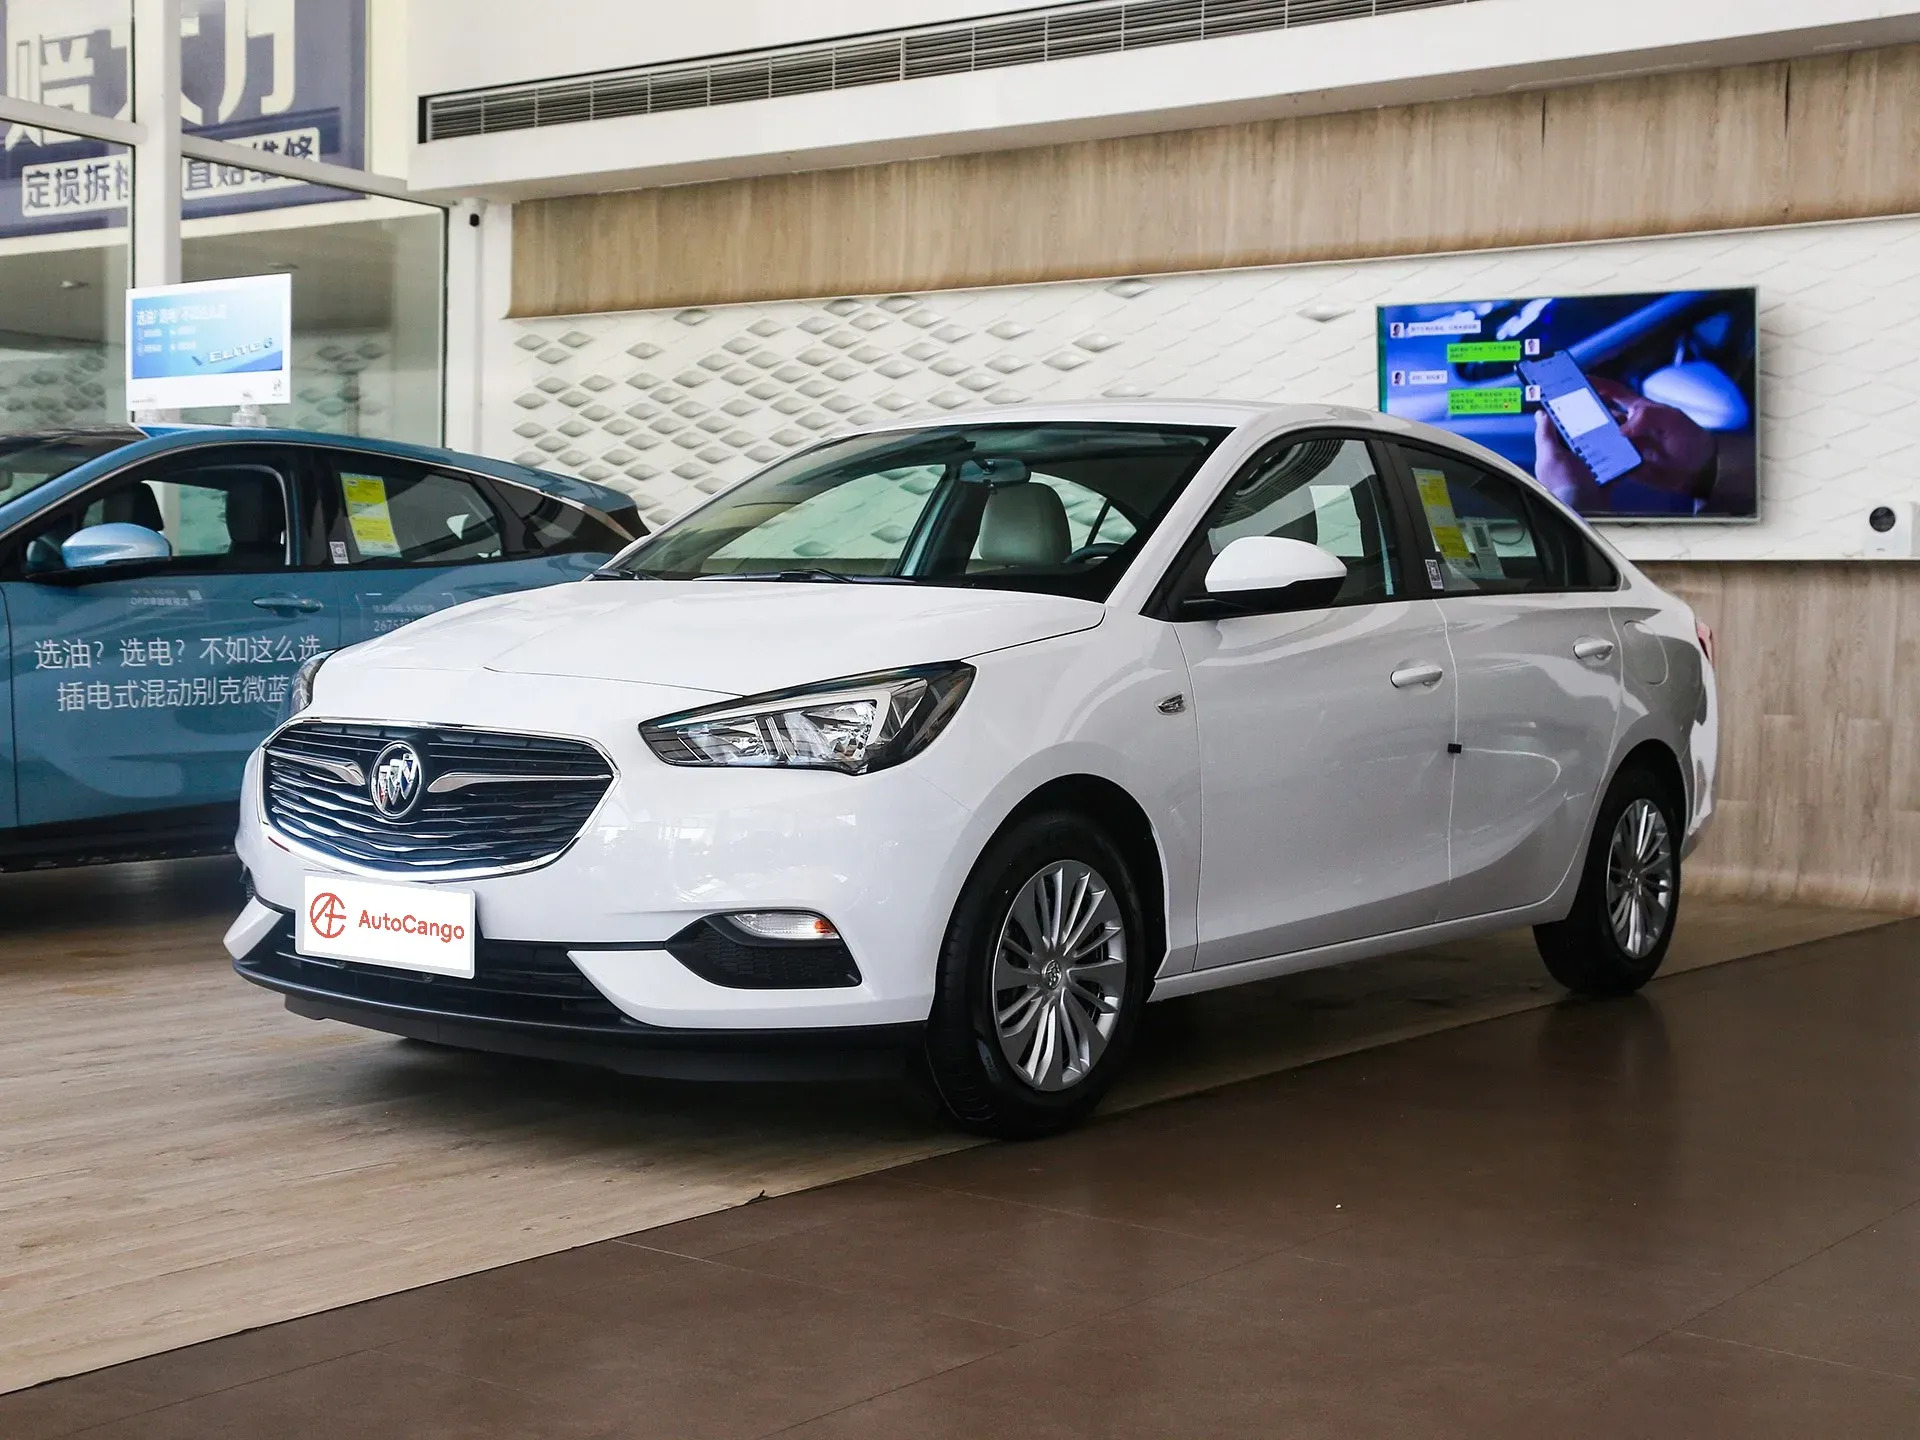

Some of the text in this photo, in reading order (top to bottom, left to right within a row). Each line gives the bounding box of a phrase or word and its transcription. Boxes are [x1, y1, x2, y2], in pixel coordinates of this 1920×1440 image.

[57, 674, 290, 712] 插电式混动别克微蓝
